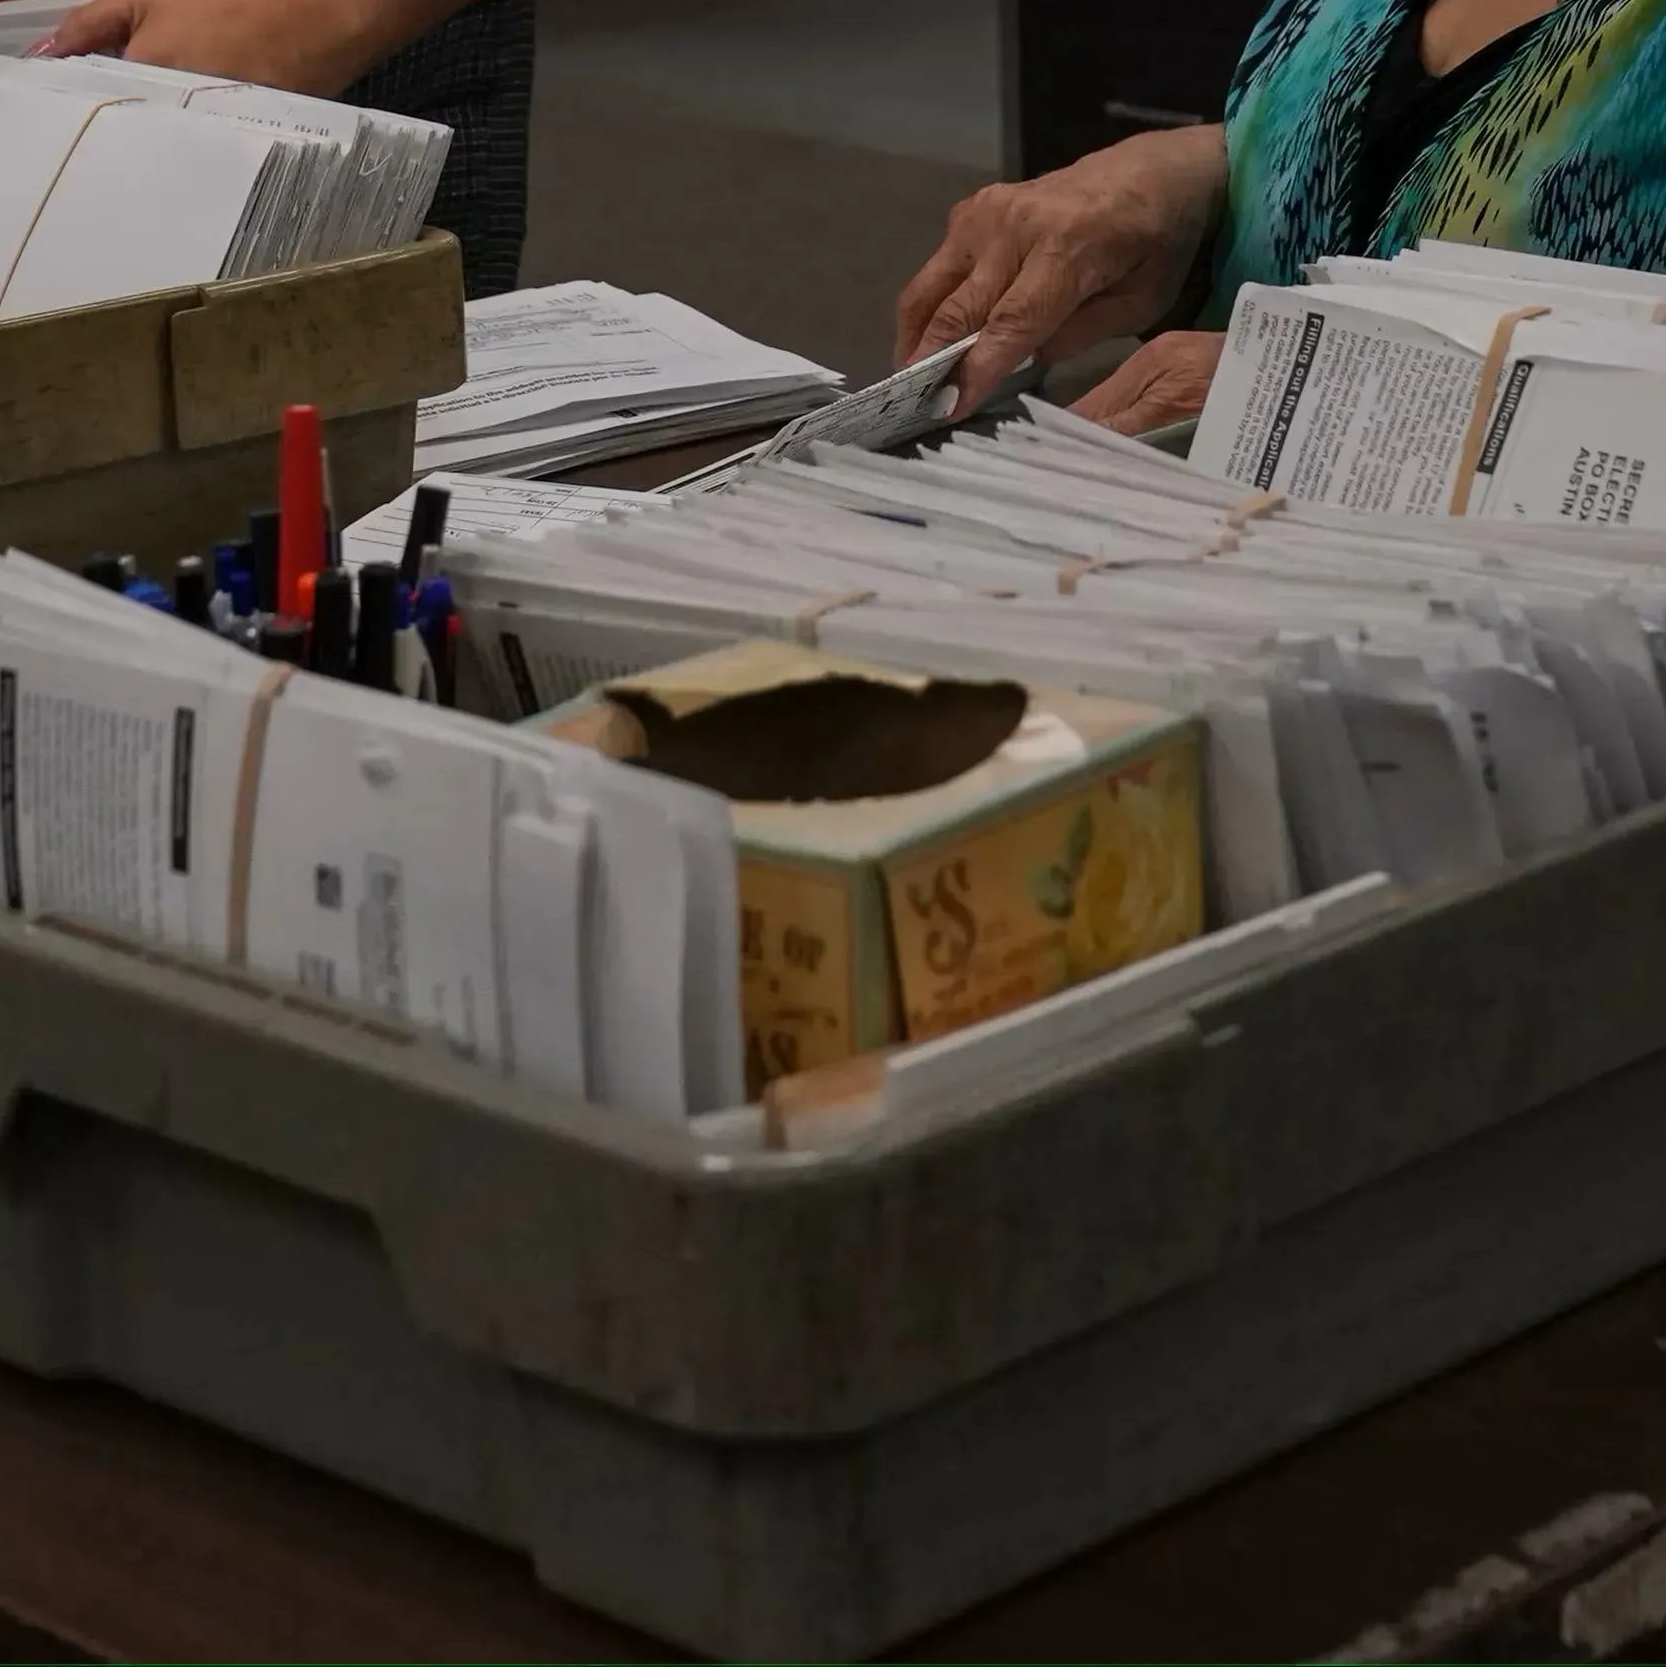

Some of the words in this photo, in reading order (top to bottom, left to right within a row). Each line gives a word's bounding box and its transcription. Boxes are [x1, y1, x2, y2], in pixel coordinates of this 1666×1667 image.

[1296, 316, 1323, 365] Filling
[1279, 393, 1297, 419] the
[1288, 365, 1306, 393] out
[1482, 364, 1529, 466] Qualifications
[1255, 419, 1287, 491] Applicati
[1558, 445, 1591, 517] AUSTIN
[1589, 449, 1610, 480] PO
[1614, 458, 1646, 525] SECRE
